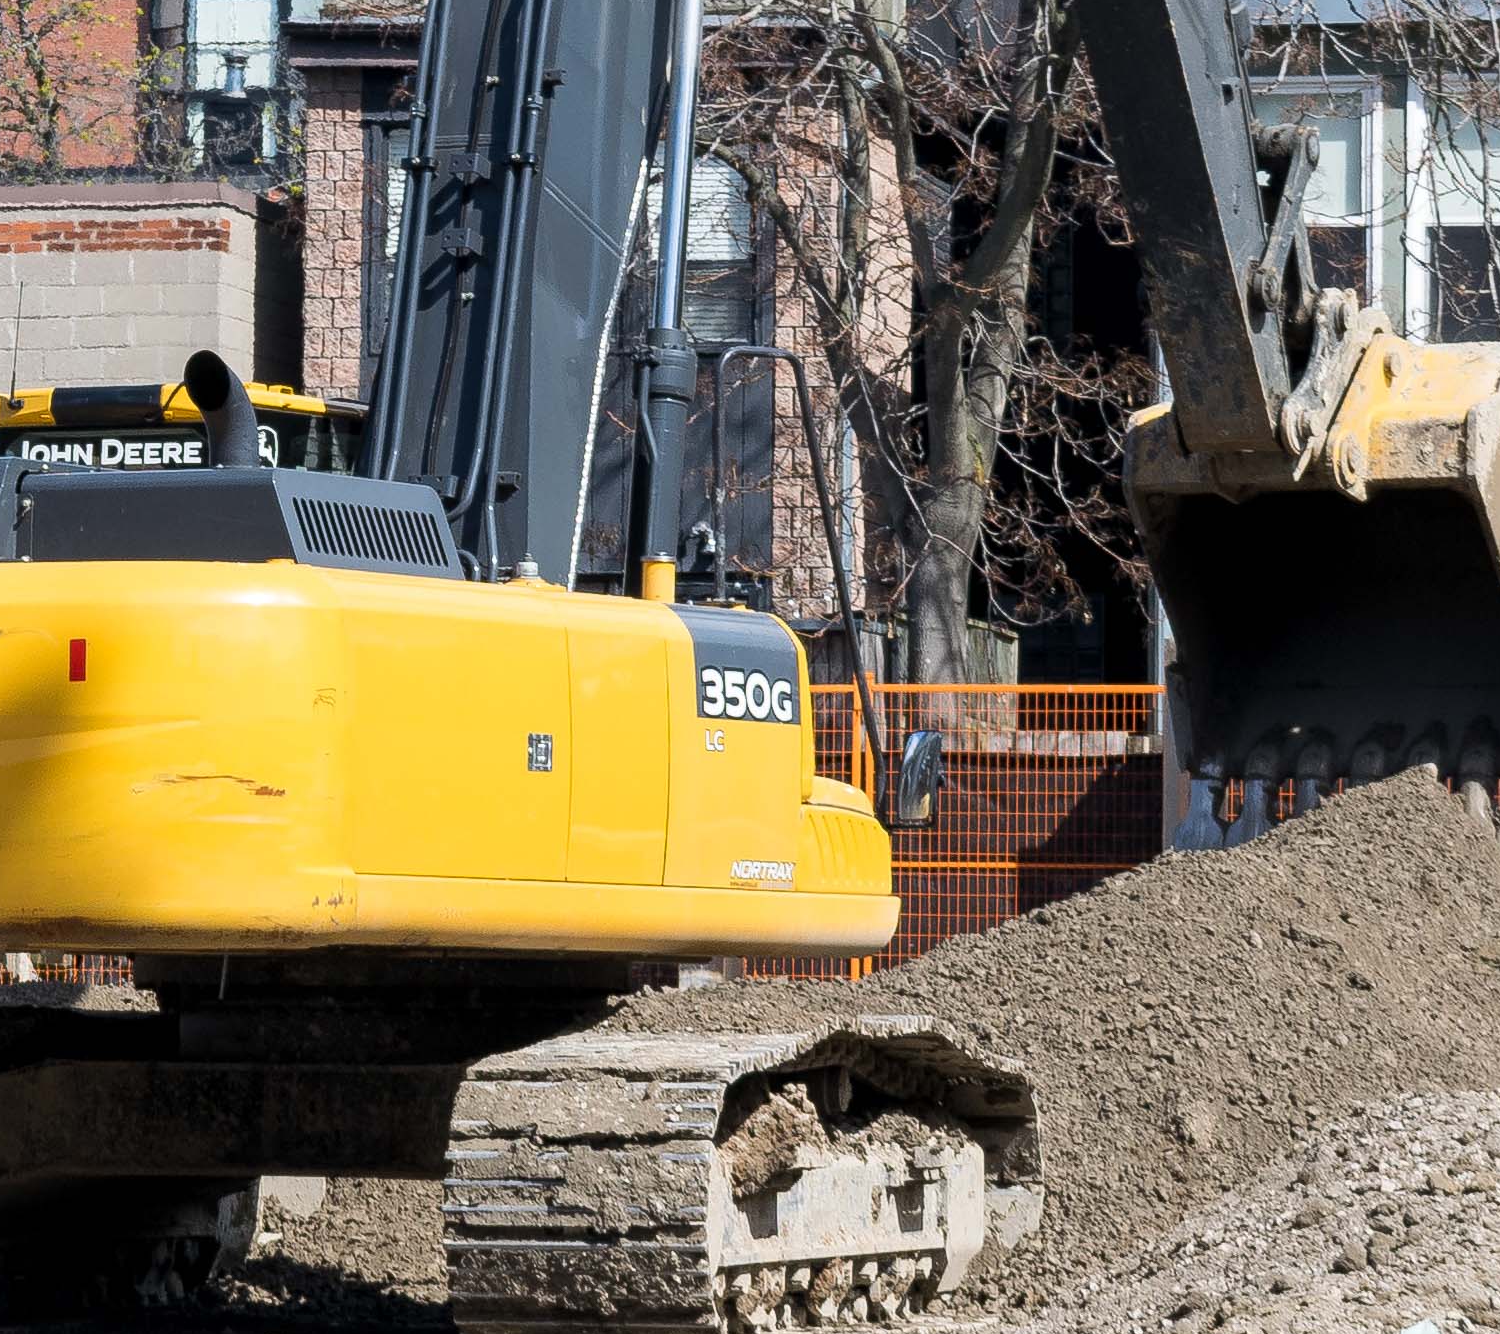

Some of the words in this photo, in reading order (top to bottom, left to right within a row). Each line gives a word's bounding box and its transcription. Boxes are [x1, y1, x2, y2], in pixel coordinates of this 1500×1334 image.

[21, 440, 94, 466] JOHN
[100, 438, 203, 465] DEERE
[701, 667, 794, 723] 350G
[704, 728, 725, 752] LC
[730, 860, 795, 882] NORTRAX
